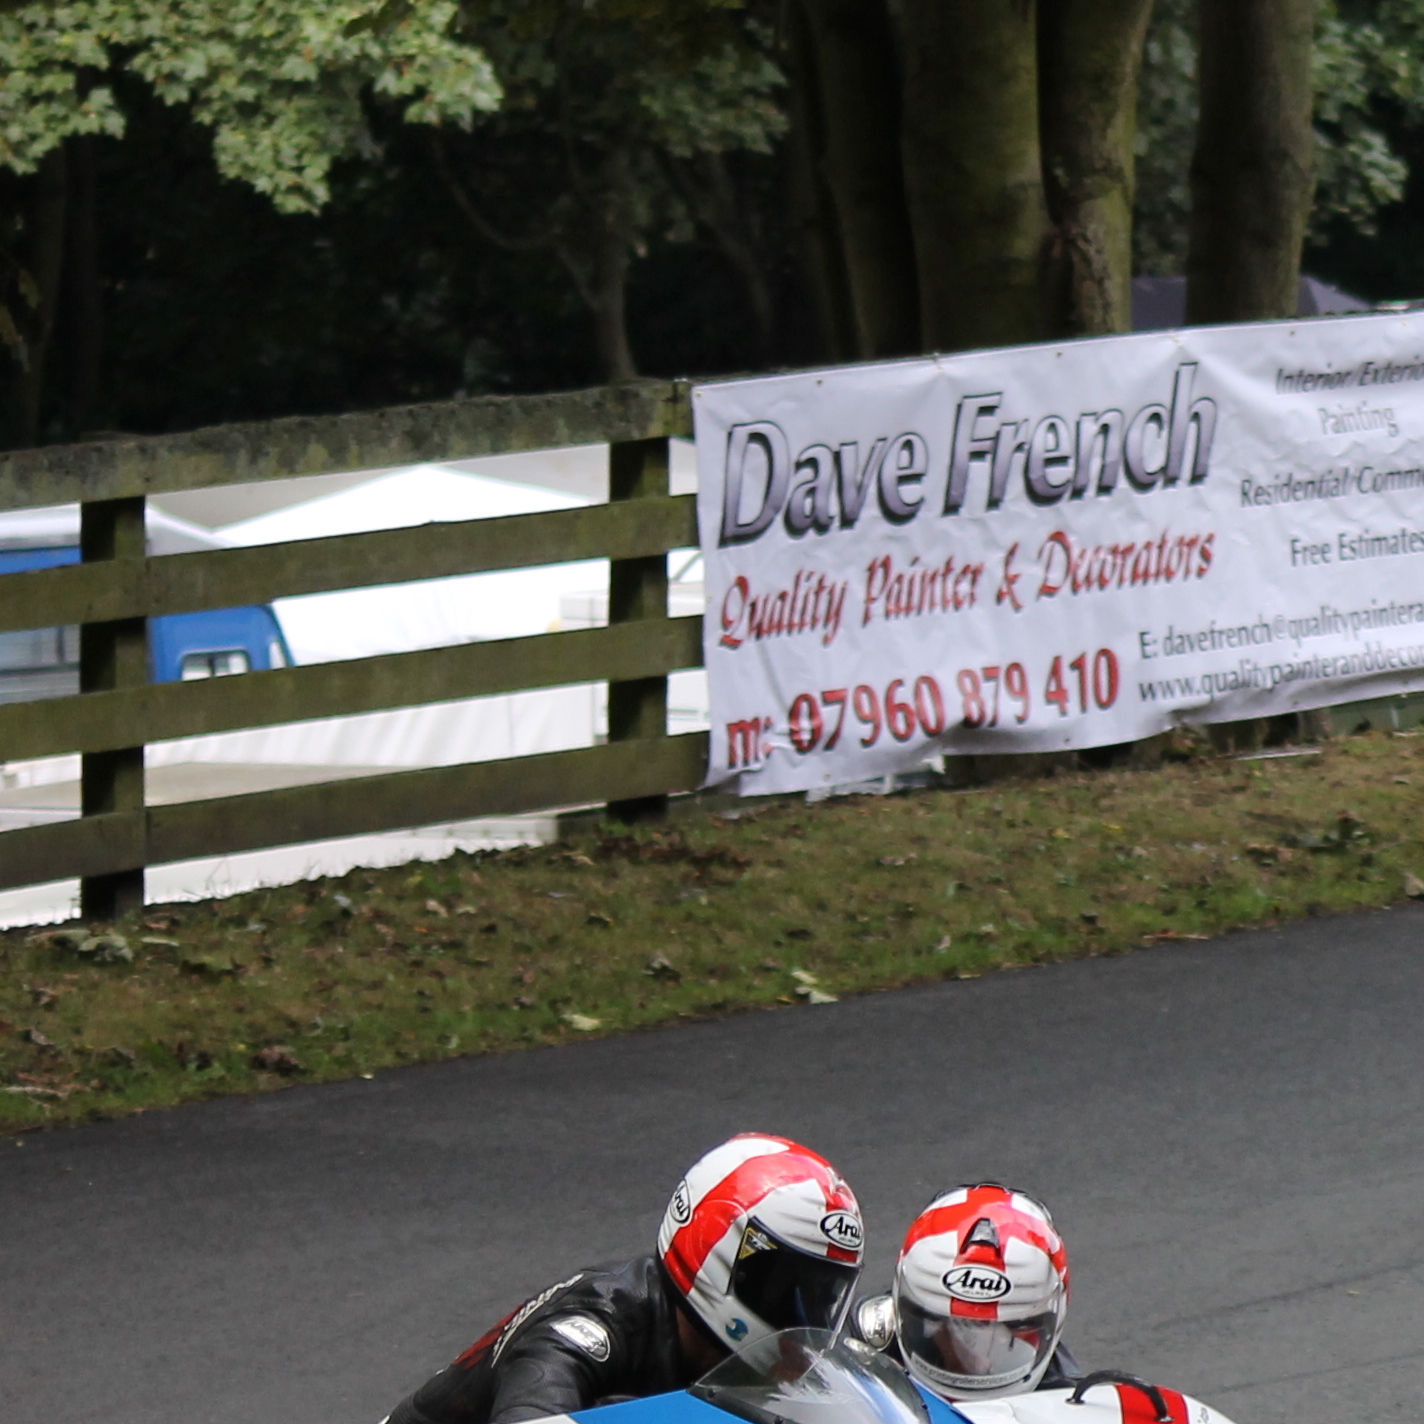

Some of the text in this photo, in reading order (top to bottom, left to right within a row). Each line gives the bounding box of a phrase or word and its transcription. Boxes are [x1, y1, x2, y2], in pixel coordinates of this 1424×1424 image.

[1317, 401, 1399, 438] Painting
[717, 361, 1218, 549] Dave French
[1290, 537, 1331, 568] Free
[717, 529, 1216, 649] Quality Painter & Decorators
[1138, 631, 1159, 660] E:
[787, 674, 946, 754] 07960
[957, 661, 1031, 730] 879
[1044, 646, 1120, 720] 410
[946, 1269, 1004, 1292] Arai
